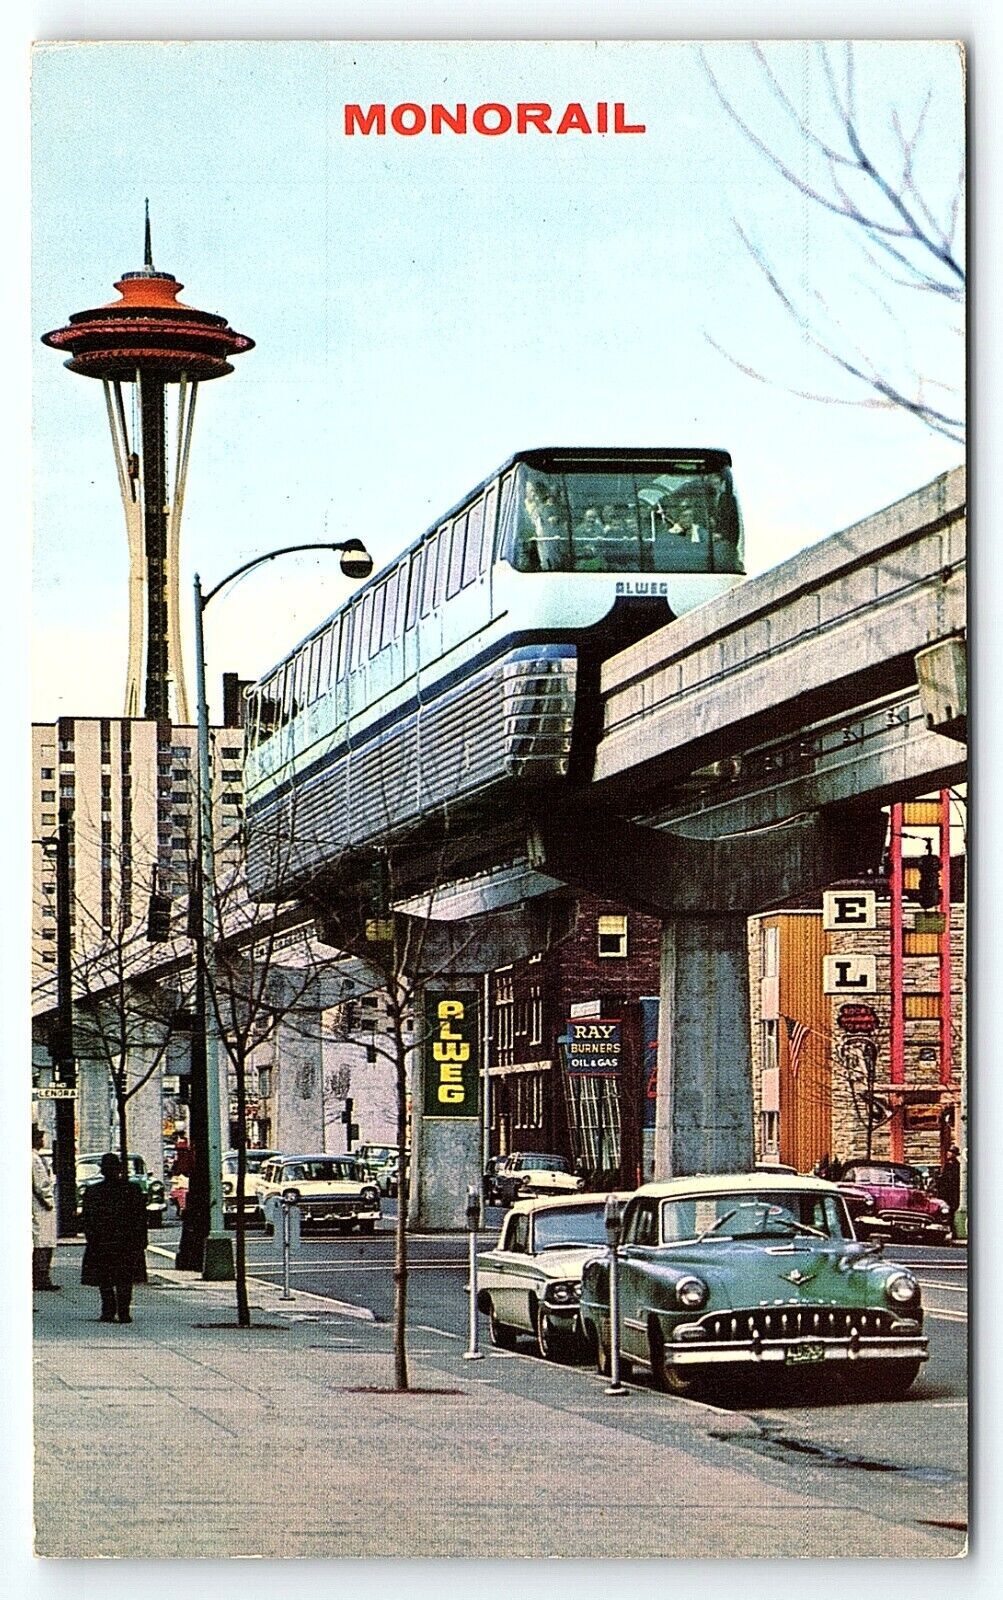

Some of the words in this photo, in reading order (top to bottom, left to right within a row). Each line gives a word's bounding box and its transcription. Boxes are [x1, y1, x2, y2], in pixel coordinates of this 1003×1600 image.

[615, 582, 668, 595] ALWEG
[574, 1025, 616, 1039] RAY
[433, 1000, 470, 1103] ALWEG
[570, 1043, 621, 1054] BURNERS
[38, 1089, 77, 1098] LENORA
